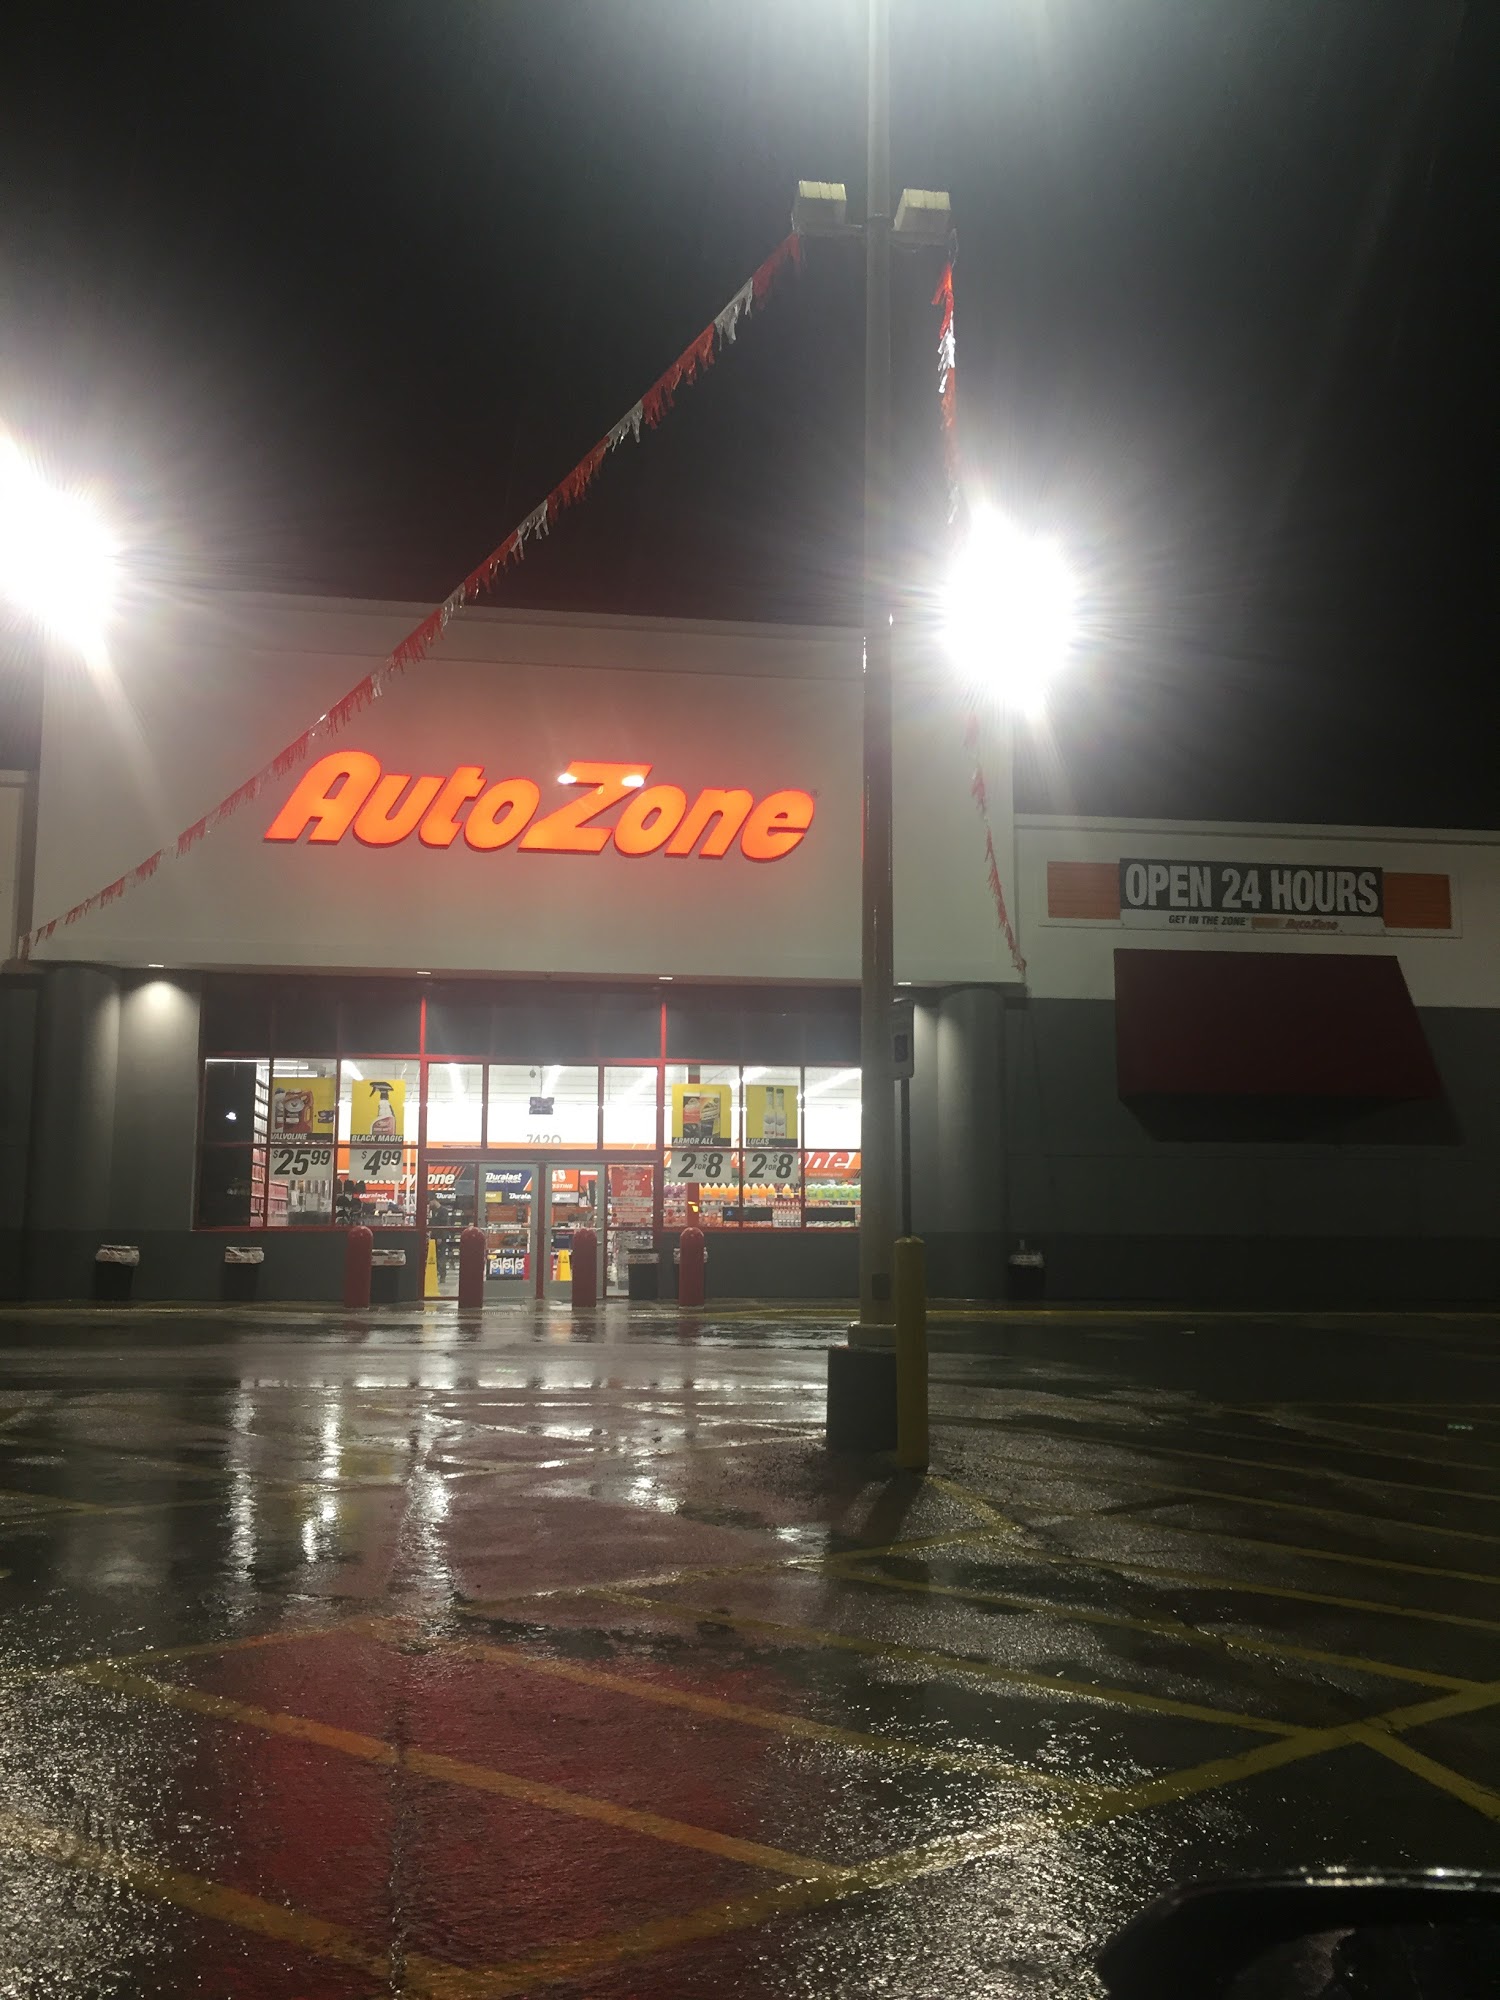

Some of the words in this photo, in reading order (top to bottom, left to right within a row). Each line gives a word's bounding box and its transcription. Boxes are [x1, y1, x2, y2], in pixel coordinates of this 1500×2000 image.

[264, 751, 815, 861] AutoZone
[1124, 863, 1212, 907] OPEN
[1221, 868, 1263, 910] 24
[1270, 869, 1380, 913] HOURS
[1168, 914, 1187, 924] GET
[1188, 915, 1199, 925] IN
[1201, 916, 1219, 926] THE
[1221, 916, 1247, 926] ZONE
[270, 1132, 308, 1140] VALVOLINE
[352, 1134, 376, 1142] BLACK
[377, 1134, 403, 1143] MAGIC
[673, 1137, 700, 1145] ARMOR
[701, 1137, 714, 1145] ALL
[746, 1138, 770, 1146] LUCAS
[677, 1153, 697, 1178] 2
[748, 1153, 768, 1179] 2
[427, 1172, 455, 1185] one
[485, 1172, 523, 1181] Duralast
[435, 1192, 456, 1200] Dural
[508, 1192, 531, 1200] Durala
